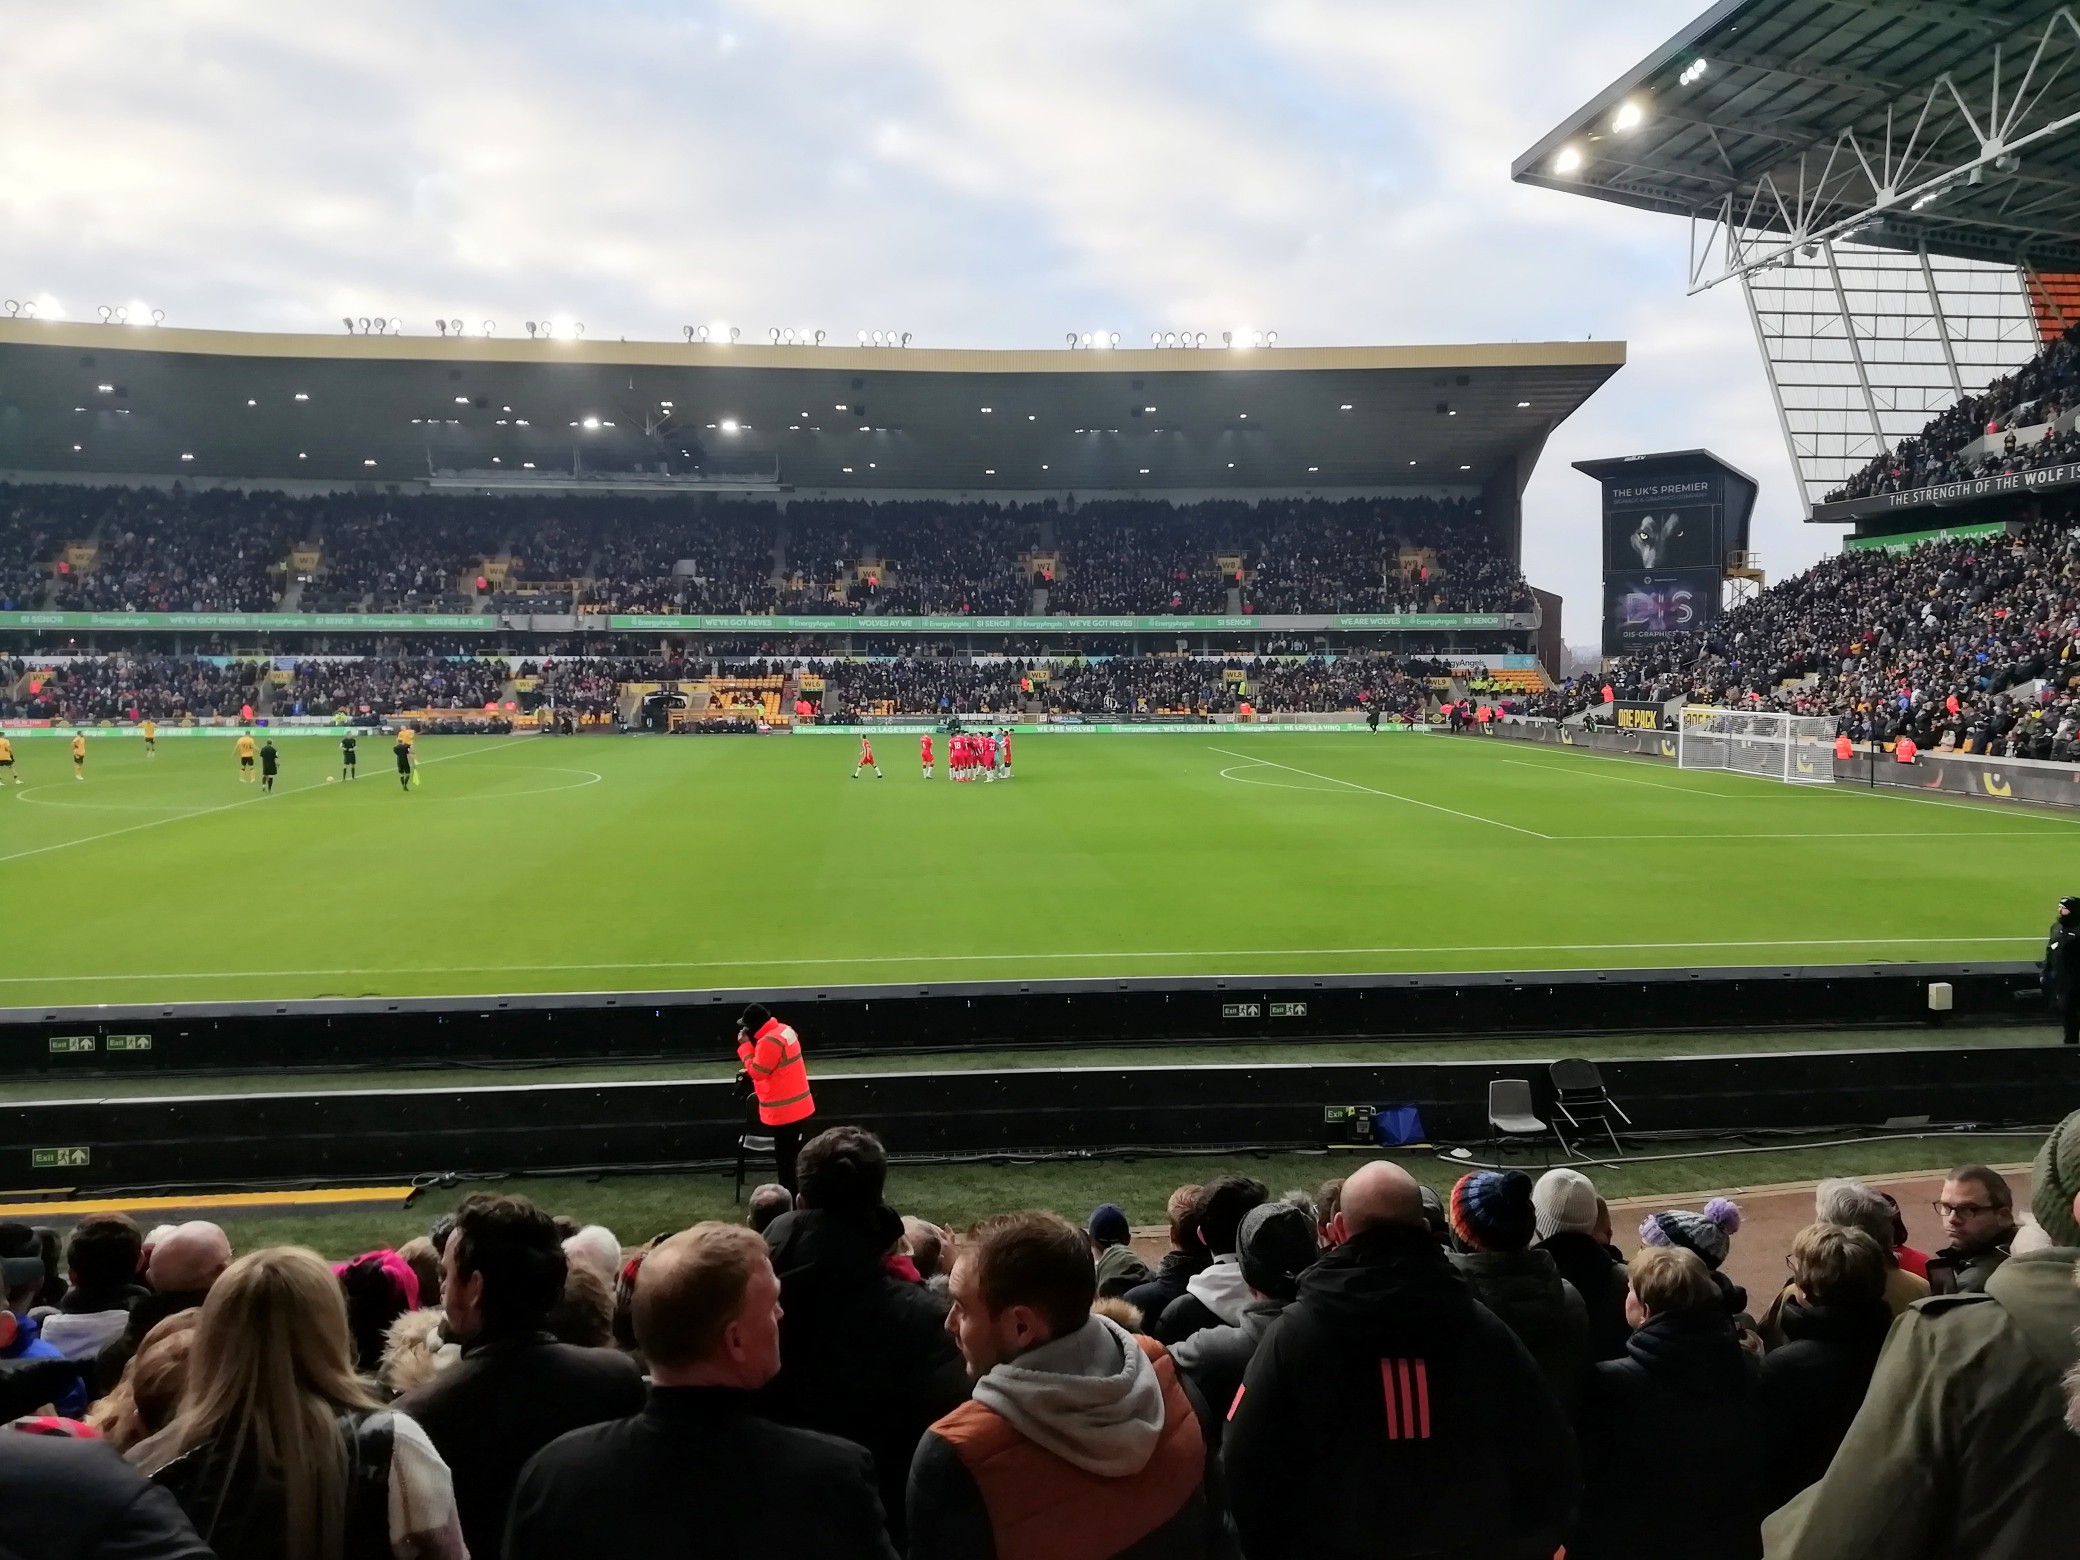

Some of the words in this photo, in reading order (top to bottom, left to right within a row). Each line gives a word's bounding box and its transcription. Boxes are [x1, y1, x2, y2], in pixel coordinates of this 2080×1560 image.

[1612, 488, 1633, 498] THE
[1635, 486, 1658, 496] UK'S
[1660, 482, 1709, 494] PREMIER
[1890, 493, 1909, 506] THE
[1913, 482, 1970, 504] STRENGTH
[1975, 480, 1991, 494] OF
[1996, 475, 2019, 490] THE
[2025, 468, 2064, 486] WOLF
[1626, 590, 1693, 624] DIS
[705, 618, 729, 626] WE'VE
[730, 618, 747, 626] GOT
[748, 618, 772, 626] NEVES
[1069, 619, 1091, 627] WE'VE
[1092, 619, 1109, 627] GOT
[1110, 619, 1133, 627] NEVES
[1340, 617, 1353, 625] WE
[1354, 617, 1369, 625] ARE
[1370, 617, 1401, 625] WOLVES
[1464, 617, 1471, 625] SI
[1472, 617, 1499, 625] SENOR
[1226, 671, 1242, 679] WL8
[804, 680, 821, 688] WL6
[1617, 708, 1634, 728] ONE
[1634, 709, 1657, 730] PACK
[52, 1041, 67, 1049] Exit
[1328, 1110, 1343, 1118] Exit
[36, 1154, 54, 1162] Exit
